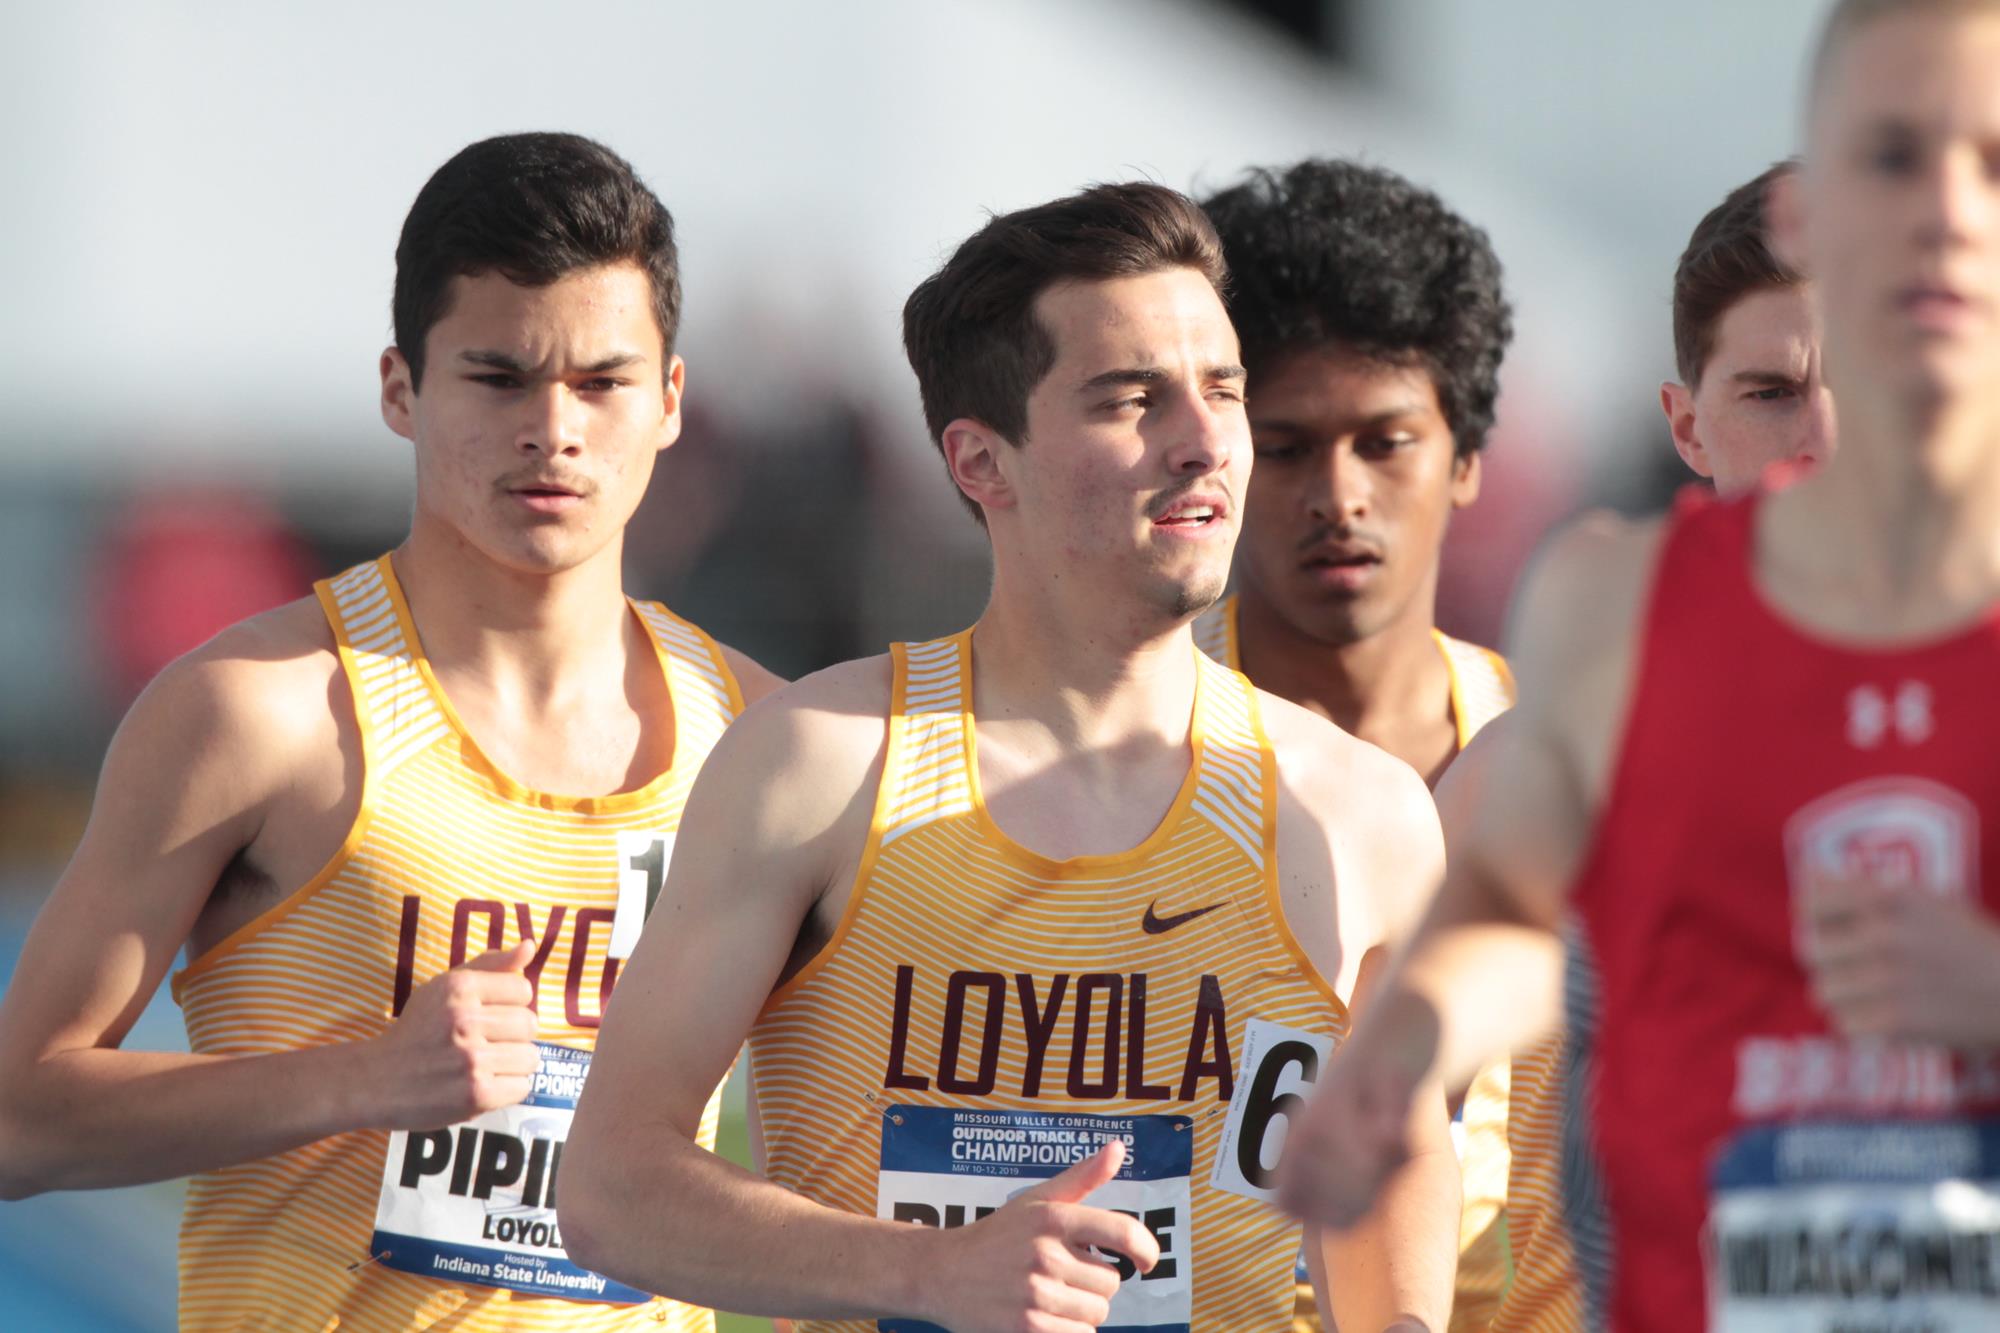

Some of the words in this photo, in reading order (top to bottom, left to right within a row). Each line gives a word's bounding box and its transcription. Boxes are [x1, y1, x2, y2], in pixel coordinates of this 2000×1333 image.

[629, 839, 665, 926] 1
[884, 965, 1234, 1102] LOYOLA
[954, 1113, 1012, 1125] MISSOURI
[1014, 1115, 1055, 1127] VALLEY
[1058, 1117, 1134, 1130] CONFERENCE
[1238, 1040, 1318, 1190] 6
[952, 1126, 1026, 1143] OUTDOOR
[1029, 1130, 1076, 1144] TRACK
[1078, 1131, 1091, 1144] &
[951, 1140, 1135, 1167] CHAMPIONSHS
[952, 1163, 970, 1173] MAY
[972, 1164, 997, 1175] 10-12,
[999, 1166, 1020, 1176] 2019
[482, 1214, 564, 1249] LOYOL
[433, 1254, 490, 1277] Indiana
[493, 1263, 534, 1284] State
[536, 1269, 607, 1295] University
[504, 1253, 535, 1267] Hosted
[535, 1256, 548, 1271] by:
